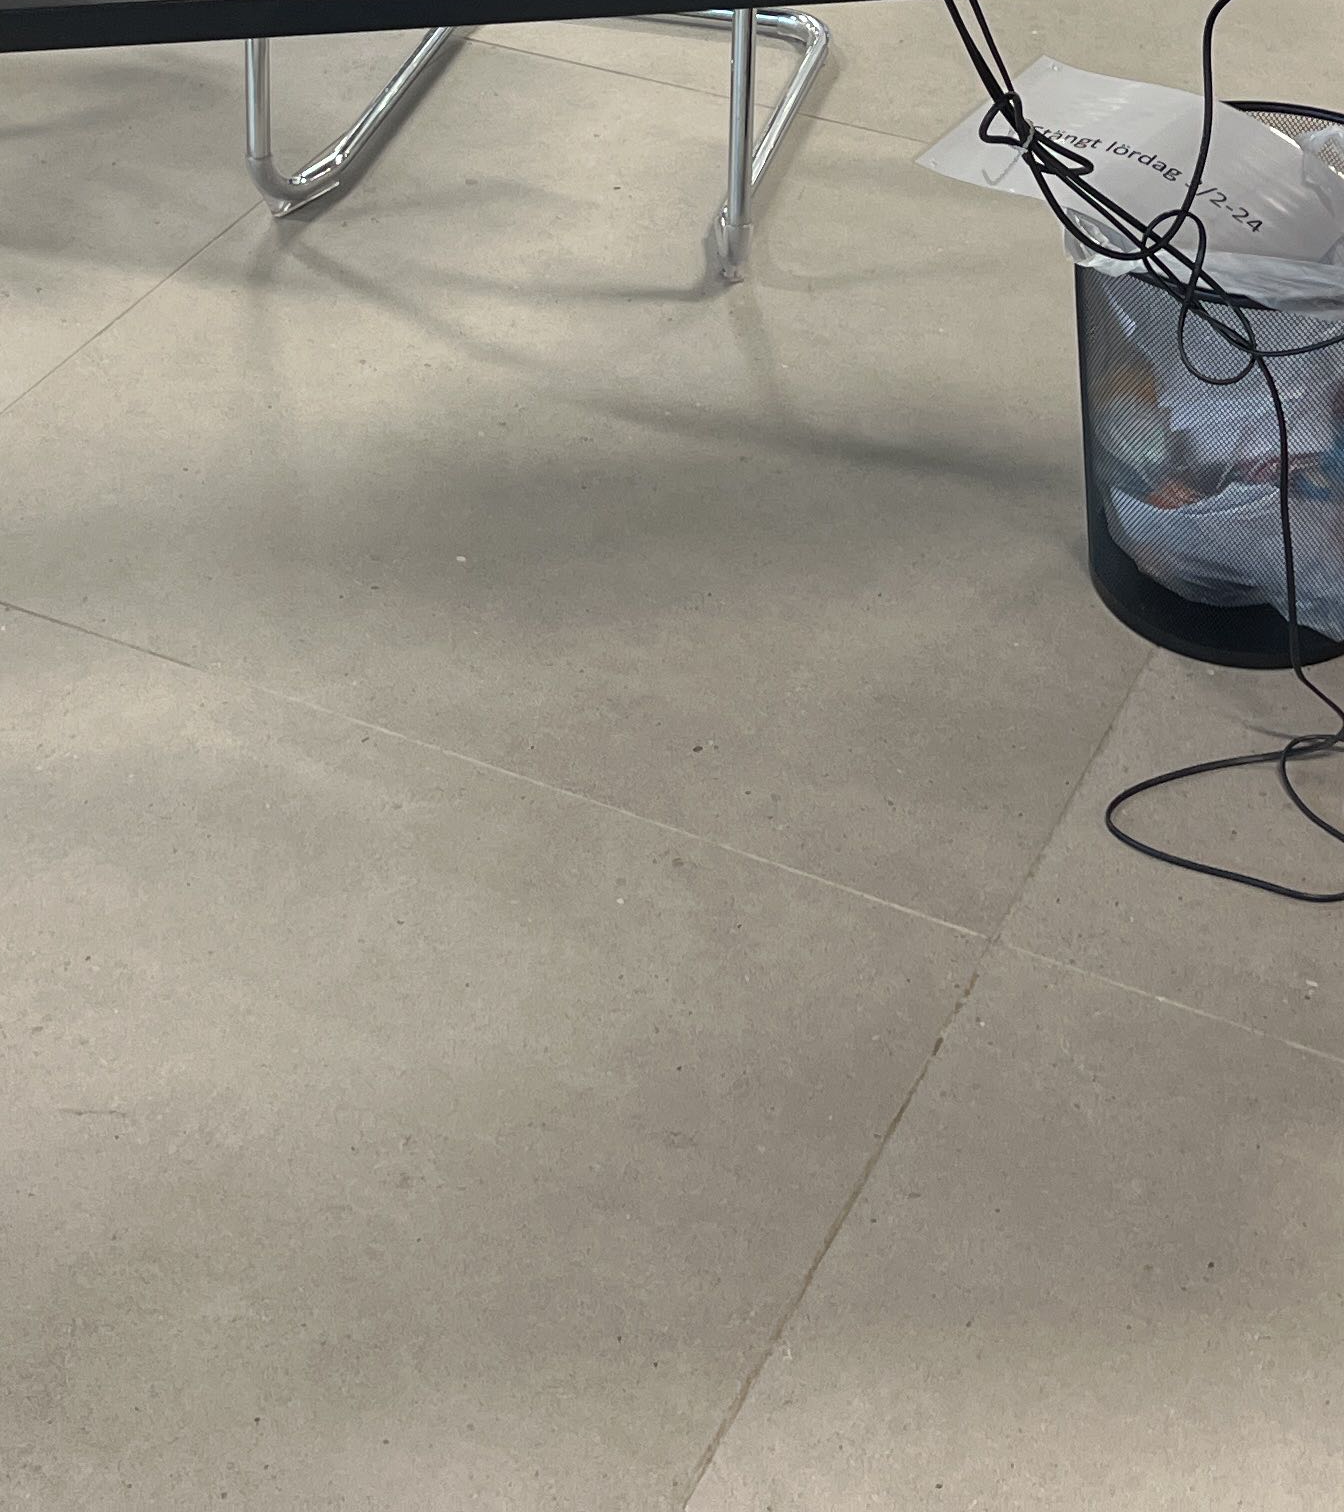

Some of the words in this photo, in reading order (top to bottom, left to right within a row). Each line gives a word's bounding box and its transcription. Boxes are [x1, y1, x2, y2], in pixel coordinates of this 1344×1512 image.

[1034, 125, 1103, 149] tängt
[1105, 140, 1183, 182] lördag
[1184, 177, 1264, 233] /2-24
